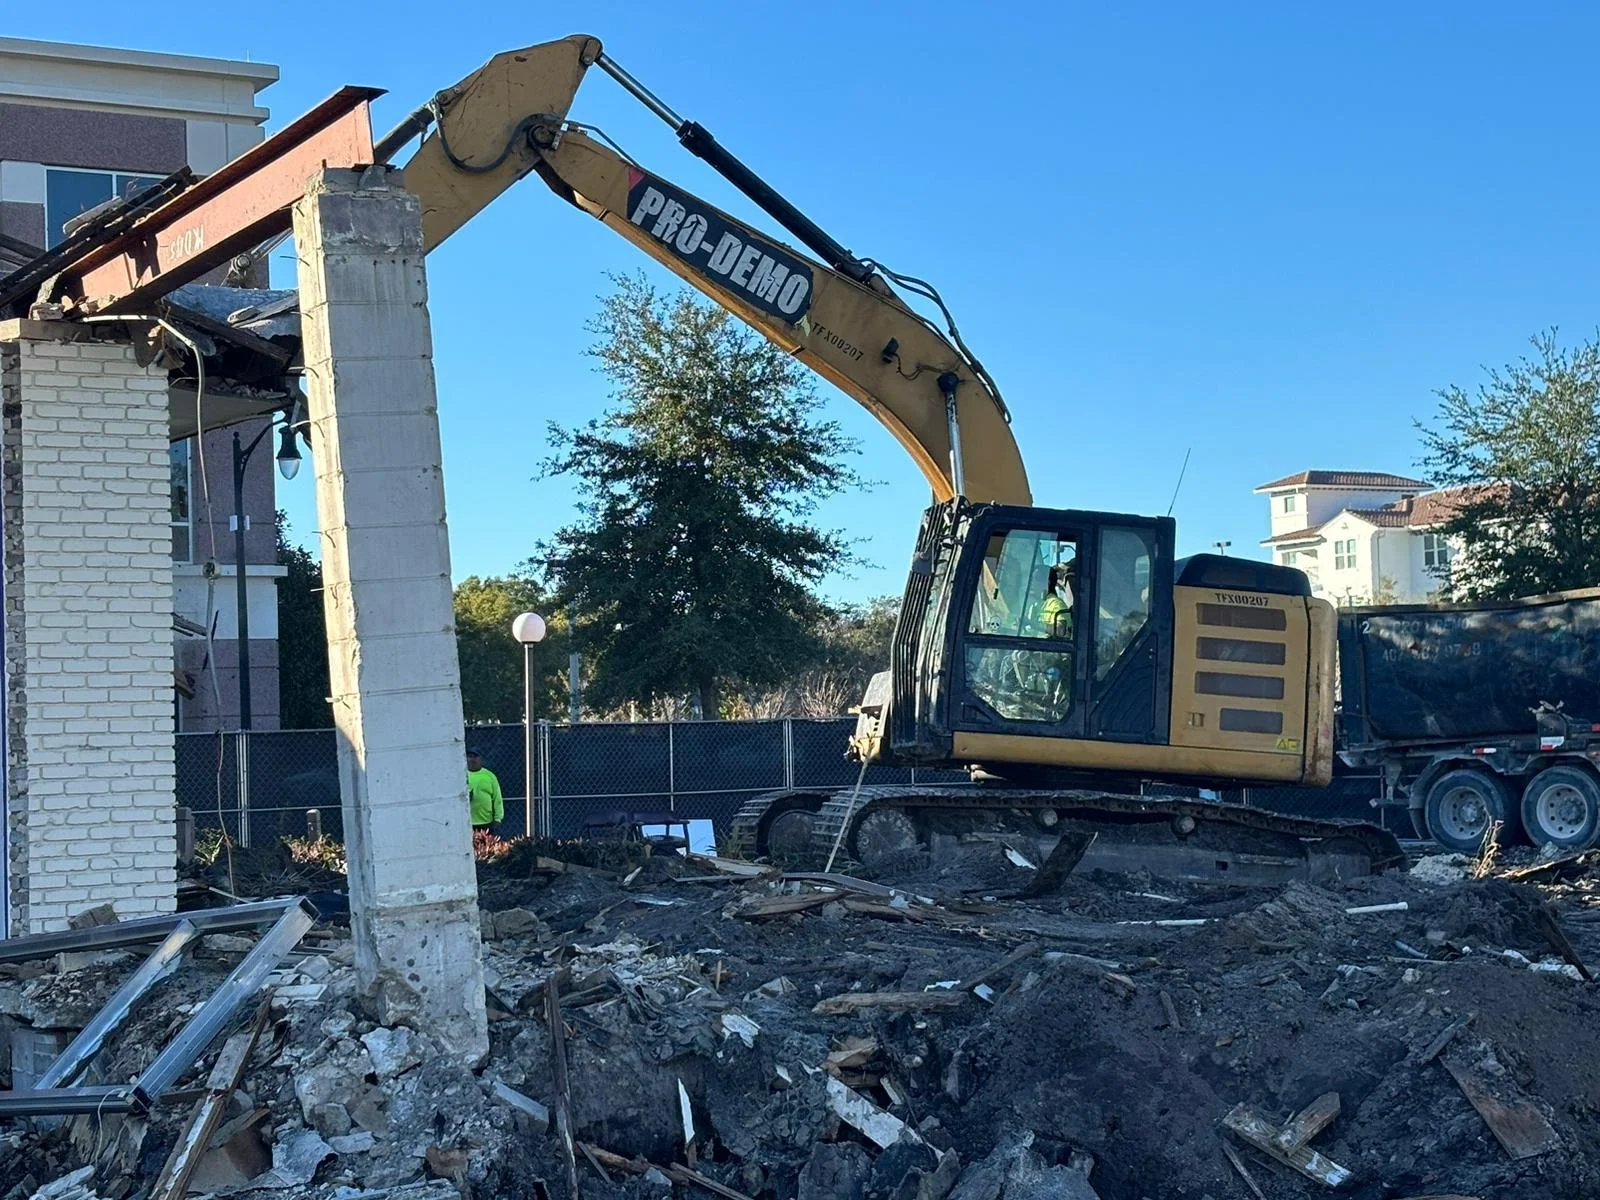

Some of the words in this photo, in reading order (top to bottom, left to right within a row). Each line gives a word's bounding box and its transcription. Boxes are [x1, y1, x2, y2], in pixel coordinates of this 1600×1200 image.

[631, 186, 810, 315] PRO-DEMO
[812, 321, 864, 361] TFX00207
[1215, 592, 1269, 606] TFX00207
